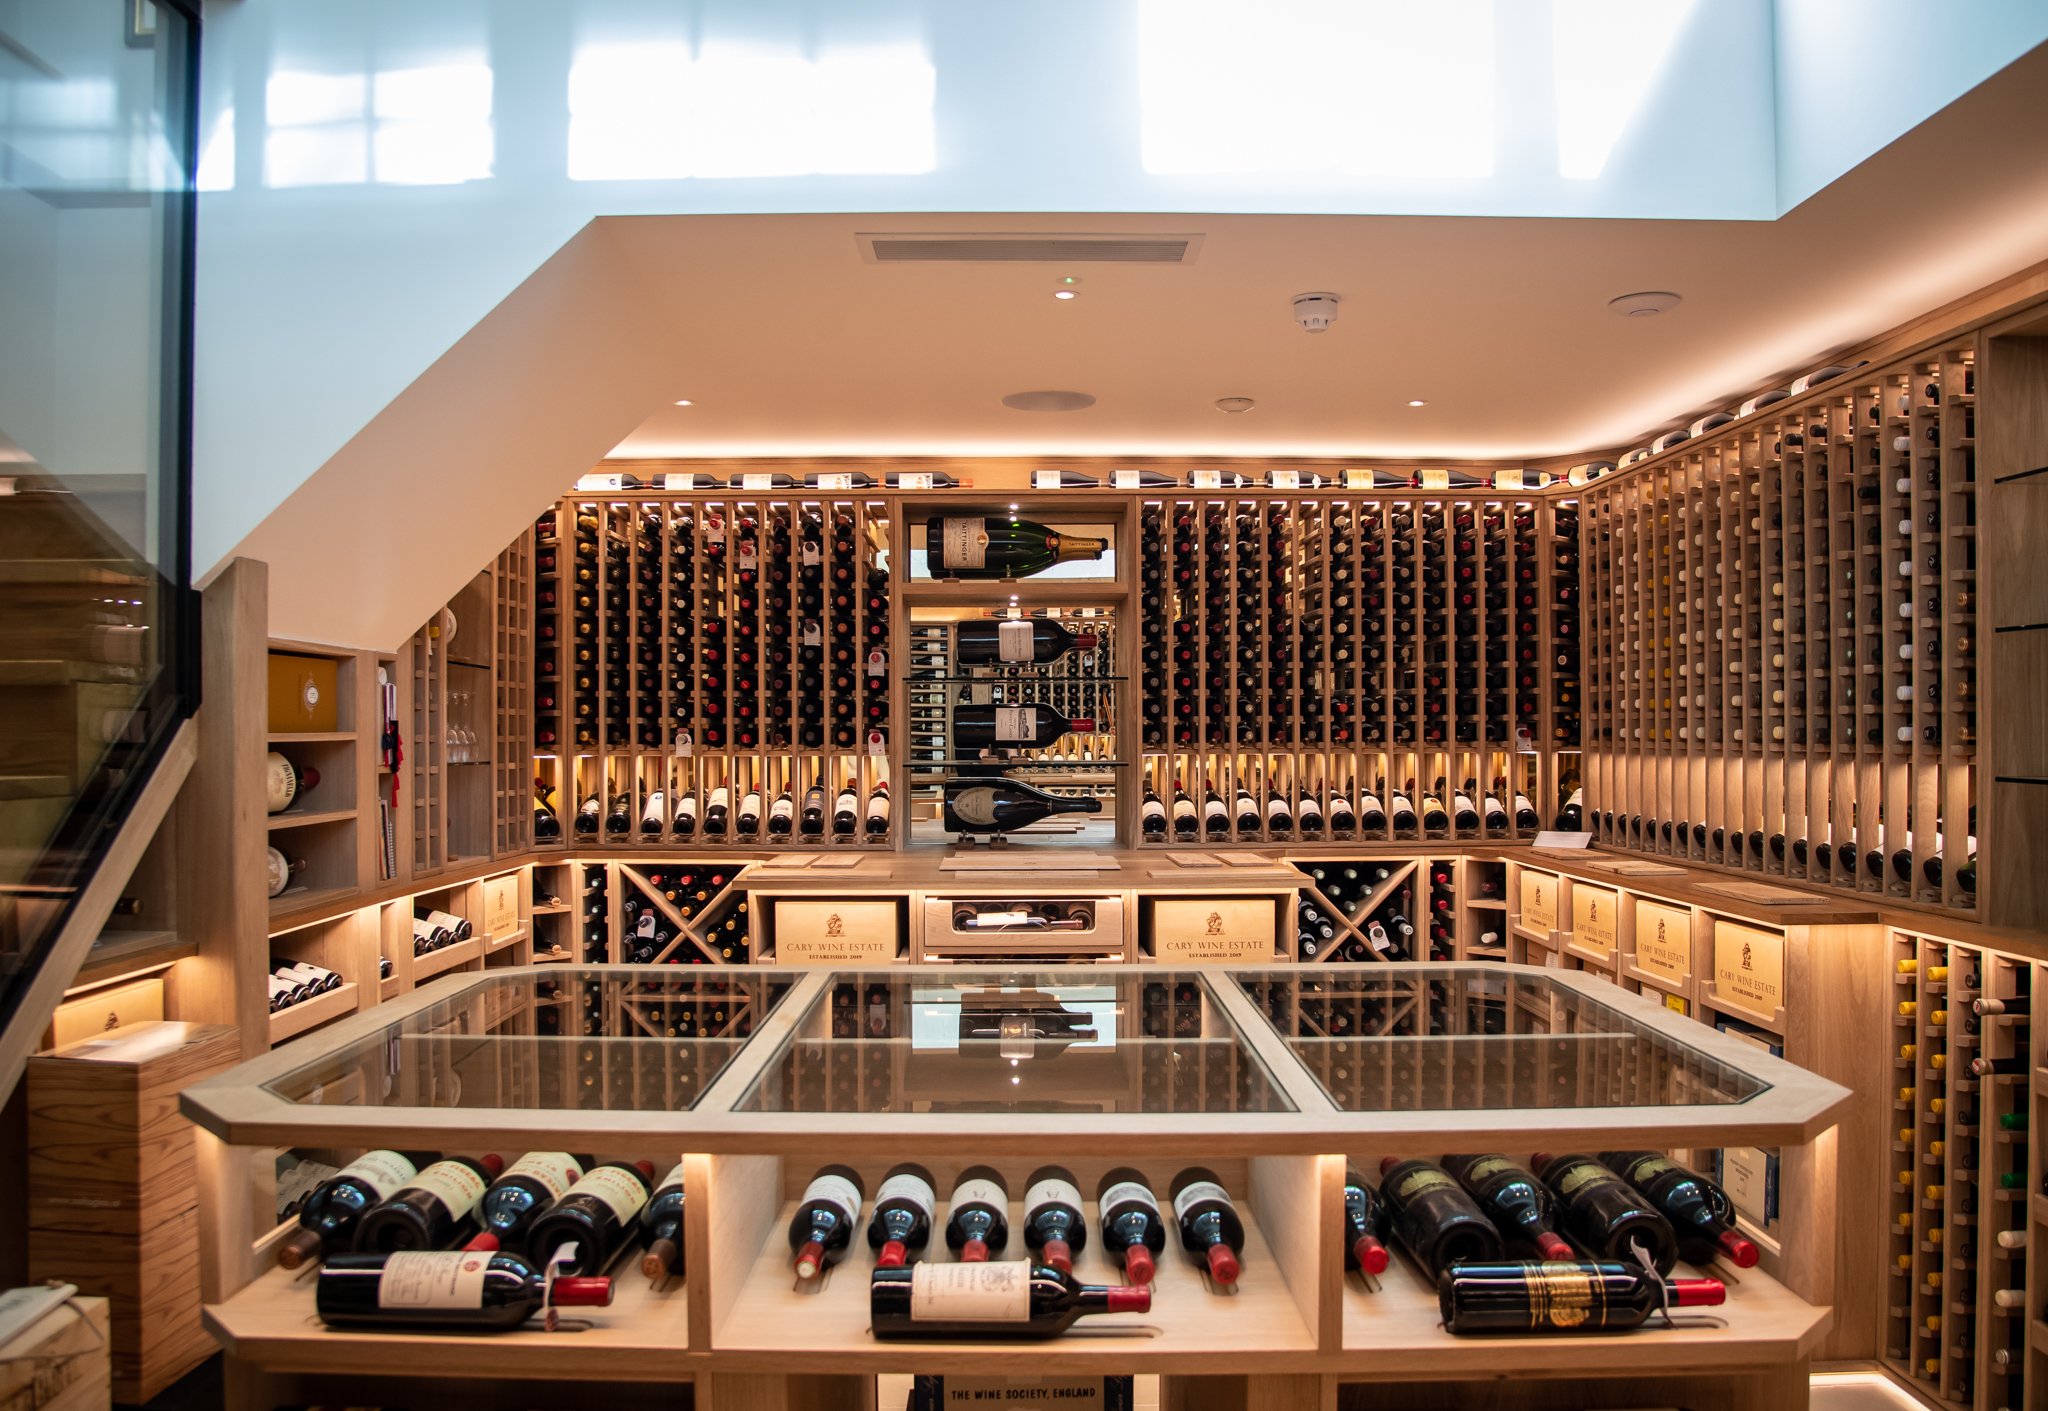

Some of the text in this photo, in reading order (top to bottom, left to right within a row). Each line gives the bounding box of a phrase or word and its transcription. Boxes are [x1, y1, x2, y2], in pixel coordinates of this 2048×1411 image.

[281, 763, 294, 798] TIGNANELLO
[786, 943, 885, 951] CARY WINE ESTATE
[1166, 941, 1264, 950] CARY WINE ESTATE
[1640, 942, 1685, 965] CARY WINE ESTATE
[1720, 969, 1776, 996] CARY WINE ESTATE
[951, 1387, 1096, 1401] THE WINE SOCIETY, ENGLAND
